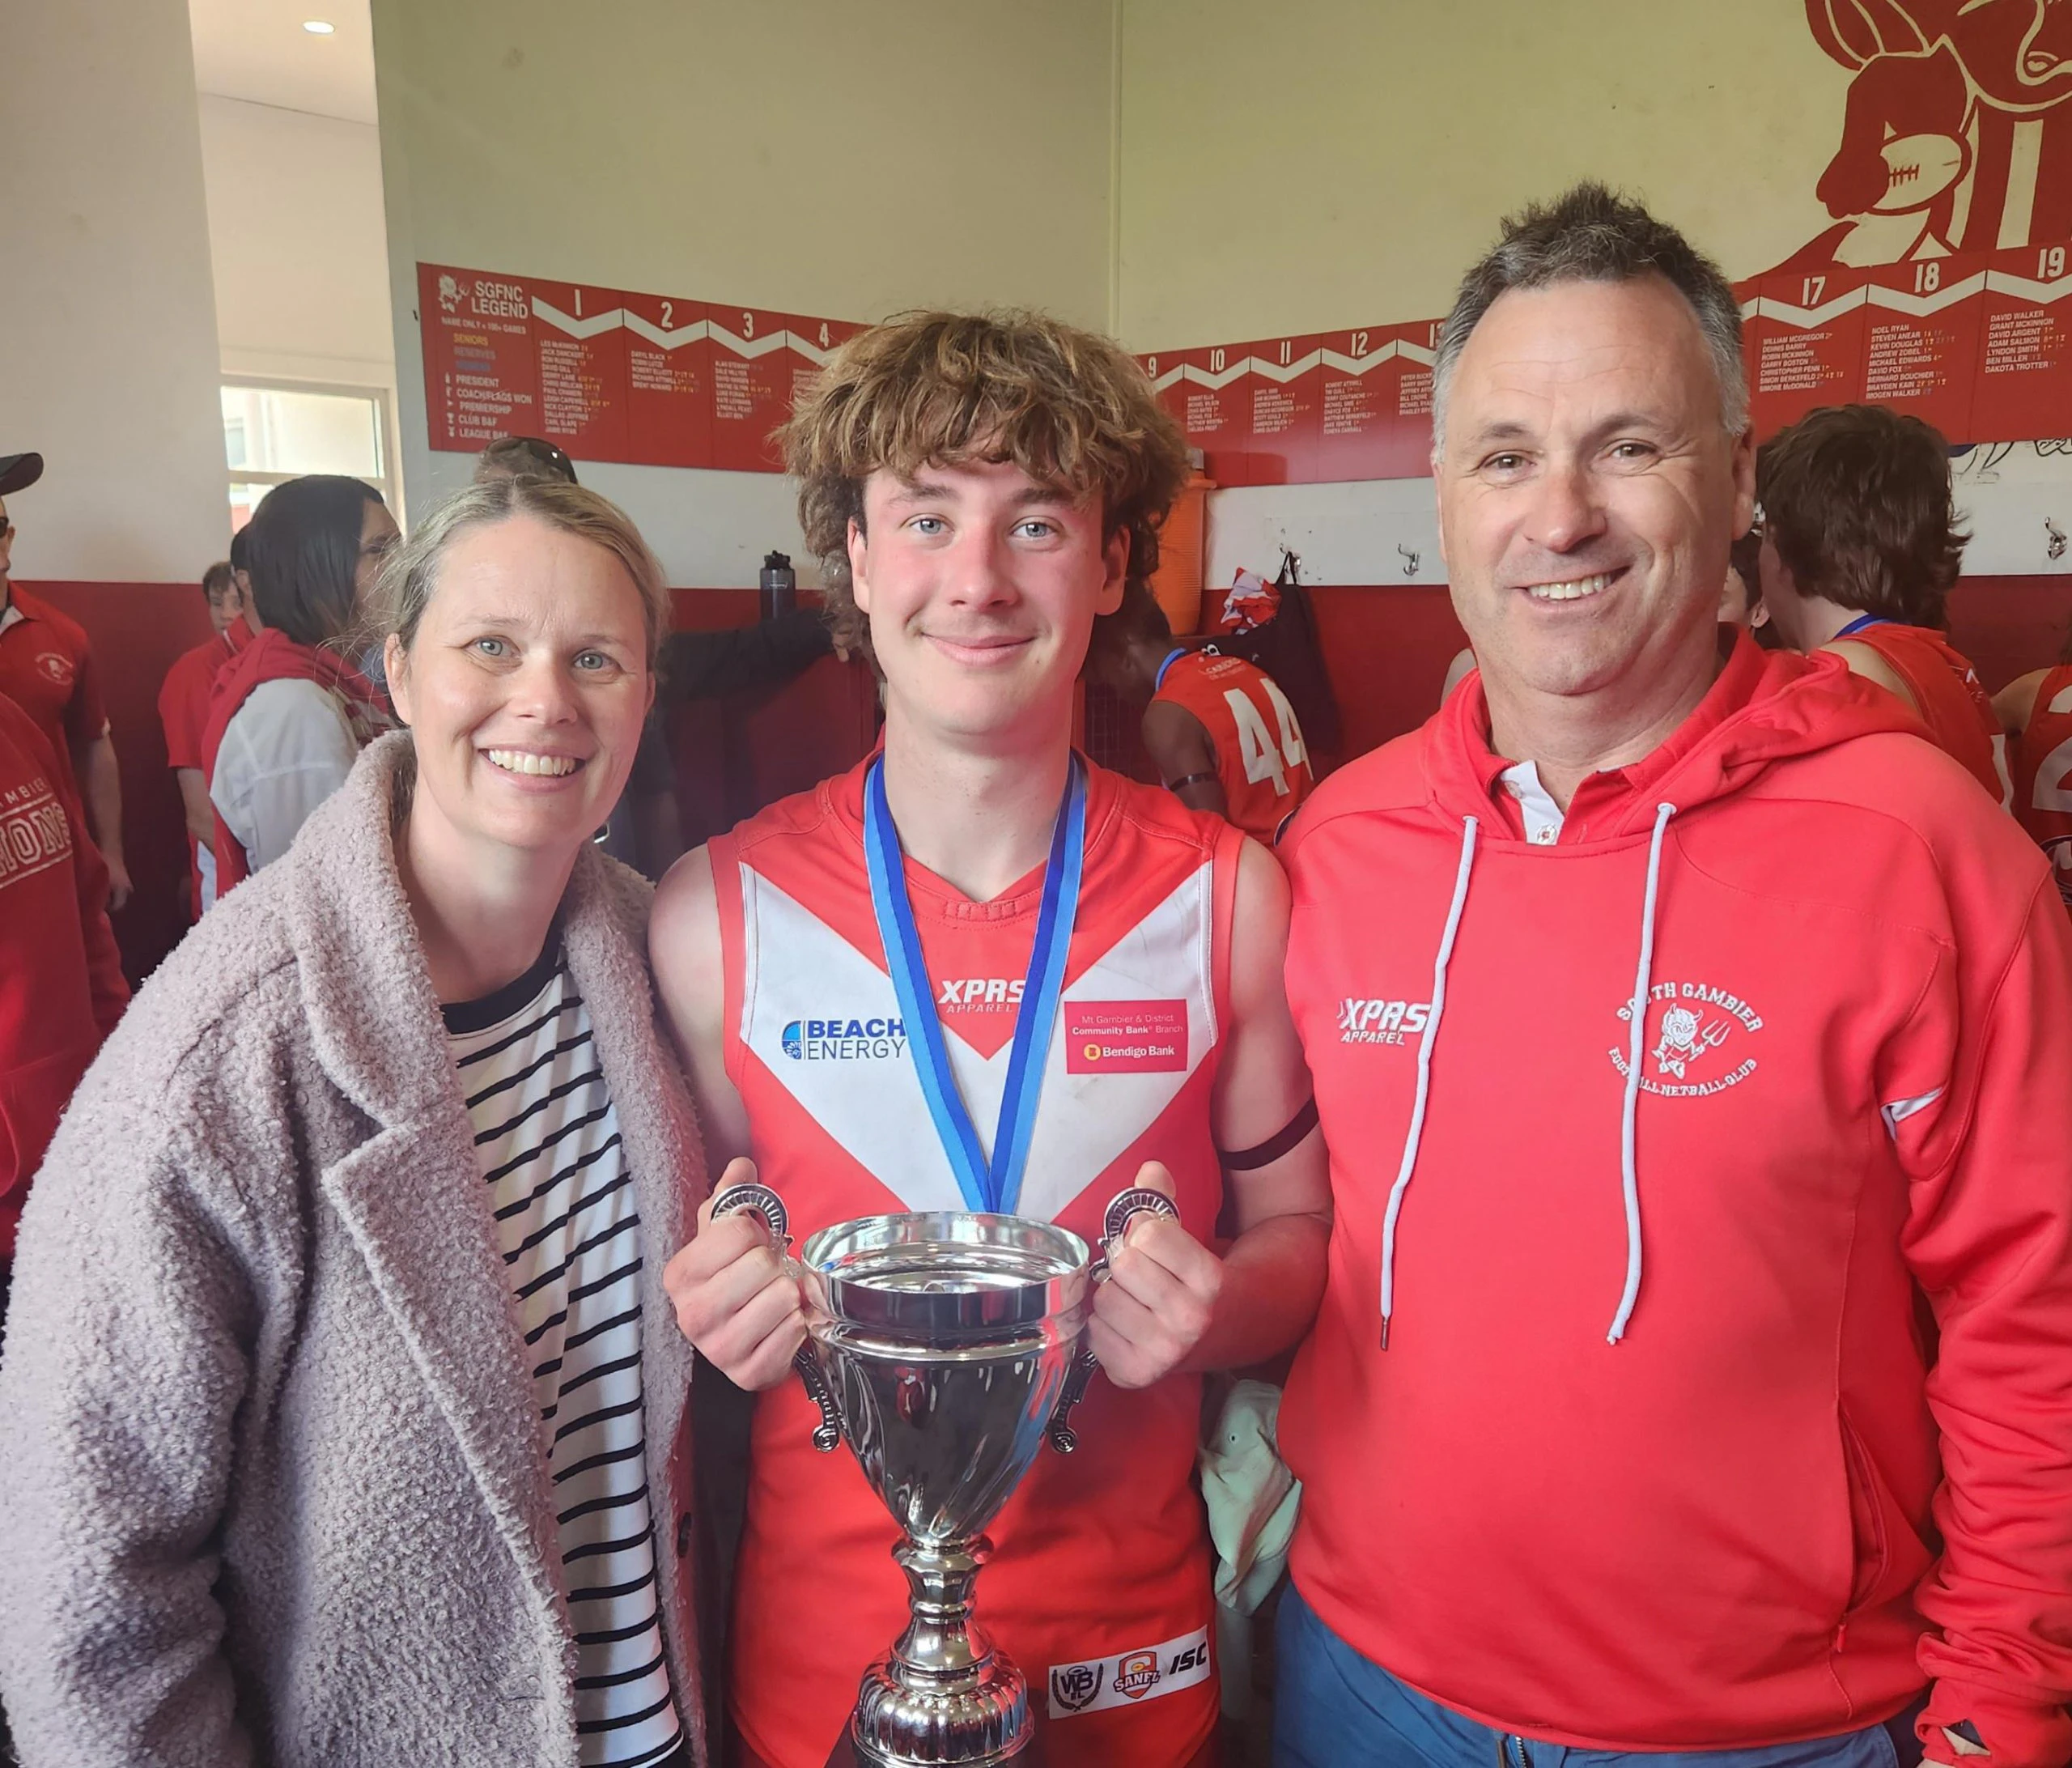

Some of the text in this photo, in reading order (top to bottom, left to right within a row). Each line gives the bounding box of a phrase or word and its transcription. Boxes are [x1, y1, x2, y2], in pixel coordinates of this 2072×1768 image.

[2037, 247, 2066, 278] 19
[1914, 262, 1940, 293] 18
[475, 281, 524, 302] SGFNC
[1802, 276, 1826, 306] 17
[471, 297, 529, 319] LEGEND
[575, 289, 582, 317] 1
[660, 301, 673, 329] 2
[1990, 310, 2044, 322] DAVID WALKER
[742, 312, 754, 338] 3
[1871, 324, 1909, 334] NOEL RYAN
[1989, 321, 2015, 330] GRANT
[453, 333, 488, 346] SENIORS
[818, 322, 830, 347] 4
[1871, 334, 1896, 343] STEVEN
[1988, 339, 2008, 348] ADAM
[2010, 336, 2040, 346] SALMON
[1989, 330, 2010, 339] DAVID
[1351, 331, 1369, 356] 12
[1870, 338, 1923, 351] KEVIN DOUGLAS
[1987, 345, 2039, 356] LYNDON SMITH
[1280, 341, 1291, 364] 11
[1870, 350, 1898, 359] ANDREW
[1985, 355, 2027, 365] BEN MILLER
[1149, 356, 1157, 378] 9
[1210, 349, 1225, 372] 10
[1868, 355, 1932, 367] MICHAEL EDWARDS
[1985, 361, 2049, 373] DAKOTA TROTTER
[456, 374, 499, 388] PRESIDENT
[1867, 374, 1899, 384] BERNARD
[513, 393, 533, 404] WON
[1892, 389, 1921, 397] WALKER
[458, 414, 480, 426] CLUB
[1223, 677, 1314, 797] 44
[938, 979, 1026, 1004] XPRS
[945, 1004, 1013, 1014] APPAREL
[1616, 982, 1764, 1032] STH GAMBIER
[1096, 1015, 1133, 1024] Gambier
[1145, 1014, 1174, 1022] District
[1339, 997, 1431, 1033] XPRS
[808, 1018, 906, 1039] BEACH
[1072, 1026, 1123, 1036] Community
[1155, 1025, 1183, 1034] Branch
[1340, 1031, 1405, 1046] APPAREL
[808, 1039, 906, 1060] ENERGY
[1102, 1047, 1147, 1058] Bendigo
[1149, 1045, 1174, 1056] Bank
[1660, 1078, 1726, 1097] NETBALL
[1169, 1642, 1207, 1676] ISC
[1114, 1669, 1161, 1694] SANFL
